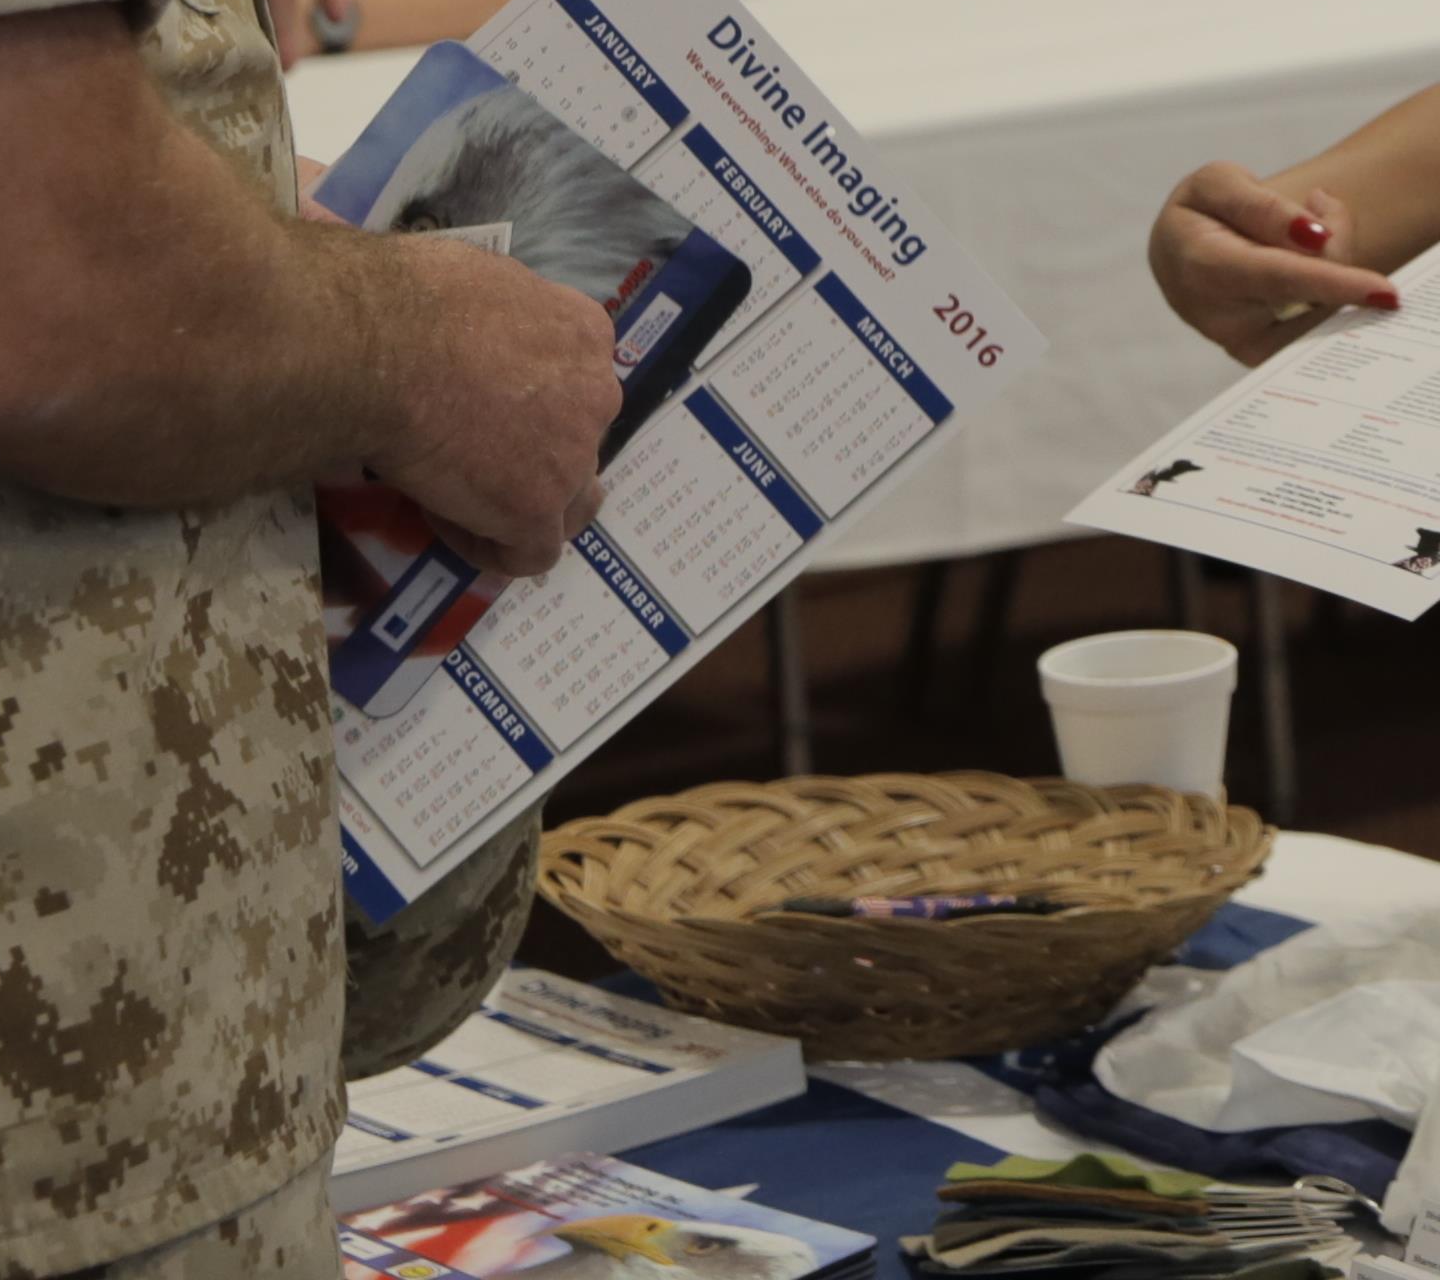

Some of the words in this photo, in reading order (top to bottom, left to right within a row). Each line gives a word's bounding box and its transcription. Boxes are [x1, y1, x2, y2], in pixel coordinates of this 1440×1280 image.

[585, 16, 656, 88] JANUARY
[687, 49, 703, 71] We
[702, 71, 724, 92] sell
[779, 153, 807, 186] What
[806, 186, 827, 209] else
[827, 209, 842, 225] do
[840, 225, 862, 248] you
[707, 16, 805, 129] Divine
[803, 122, 926, 265] Imaging
[932, 294, 1004, 368] 2016
[715, 157, 792, 240] FEBRUARY
[858, 317, 913, 378] MARCH
[733, 443, 775, 486] JUNE
[579, 532, 664, 628] SEPTEMBER
[447, 650, 525, 740] DECEMBER
